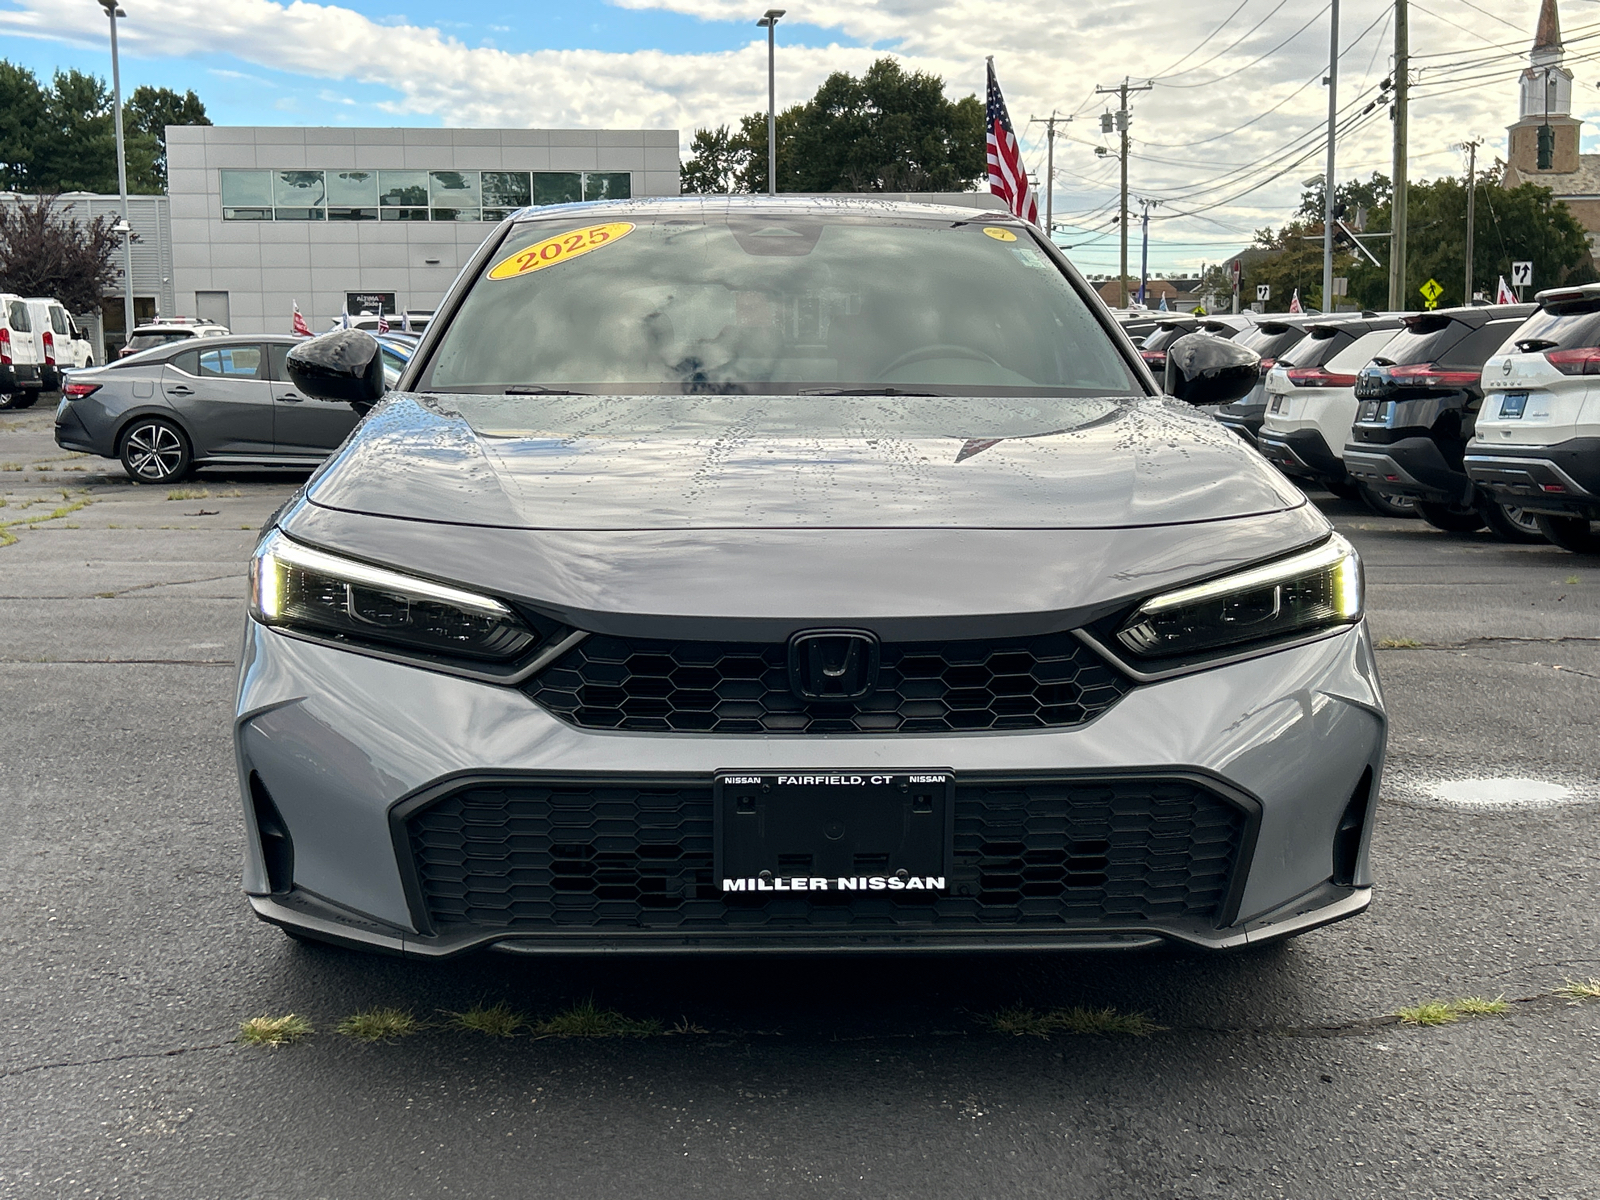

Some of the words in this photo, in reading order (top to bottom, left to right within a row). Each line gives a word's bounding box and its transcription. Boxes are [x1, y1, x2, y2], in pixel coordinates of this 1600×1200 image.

[516, 227, 610, 272] 2025
[778, 776, 866, 786] FAIRFIELD,
[870, 775, 894, 785] CT
[909, 775, 946, 783] NISSAN
[723, 878, 828, 891] MILLER
[837, 877, 946, 890] NISSAN
